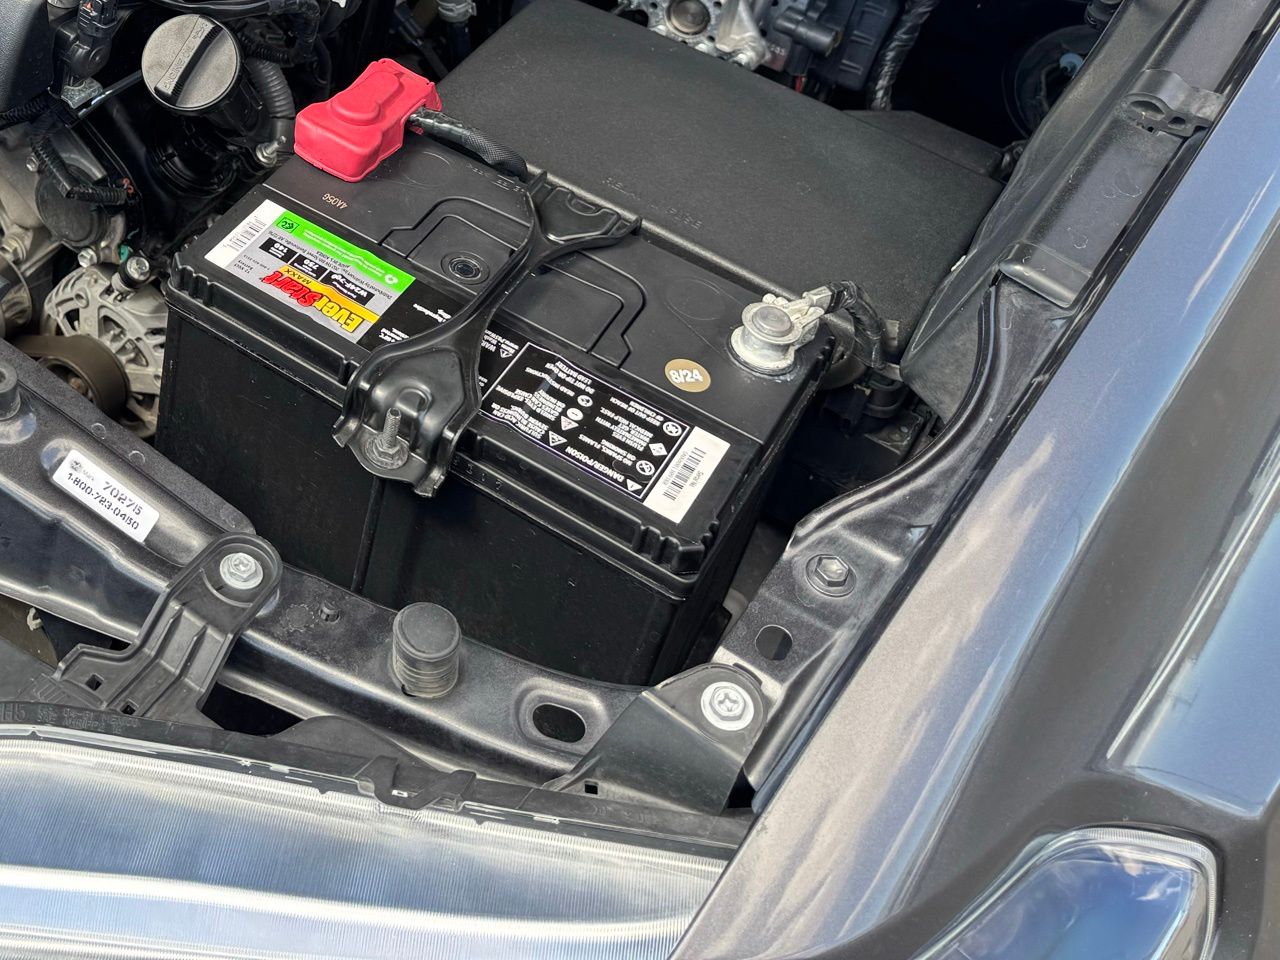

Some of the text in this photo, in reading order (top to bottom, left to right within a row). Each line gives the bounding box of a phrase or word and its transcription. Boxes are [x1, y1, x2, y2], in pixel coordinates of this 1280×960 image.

[272, 241, 289, 253] 140
[283, 266, 312, 286] MAXX
[261, 270, 365, 334] EverStart
[669, 369, 703, 383] 8/24
[564, 444, 625, 482] DANGER/POISON
